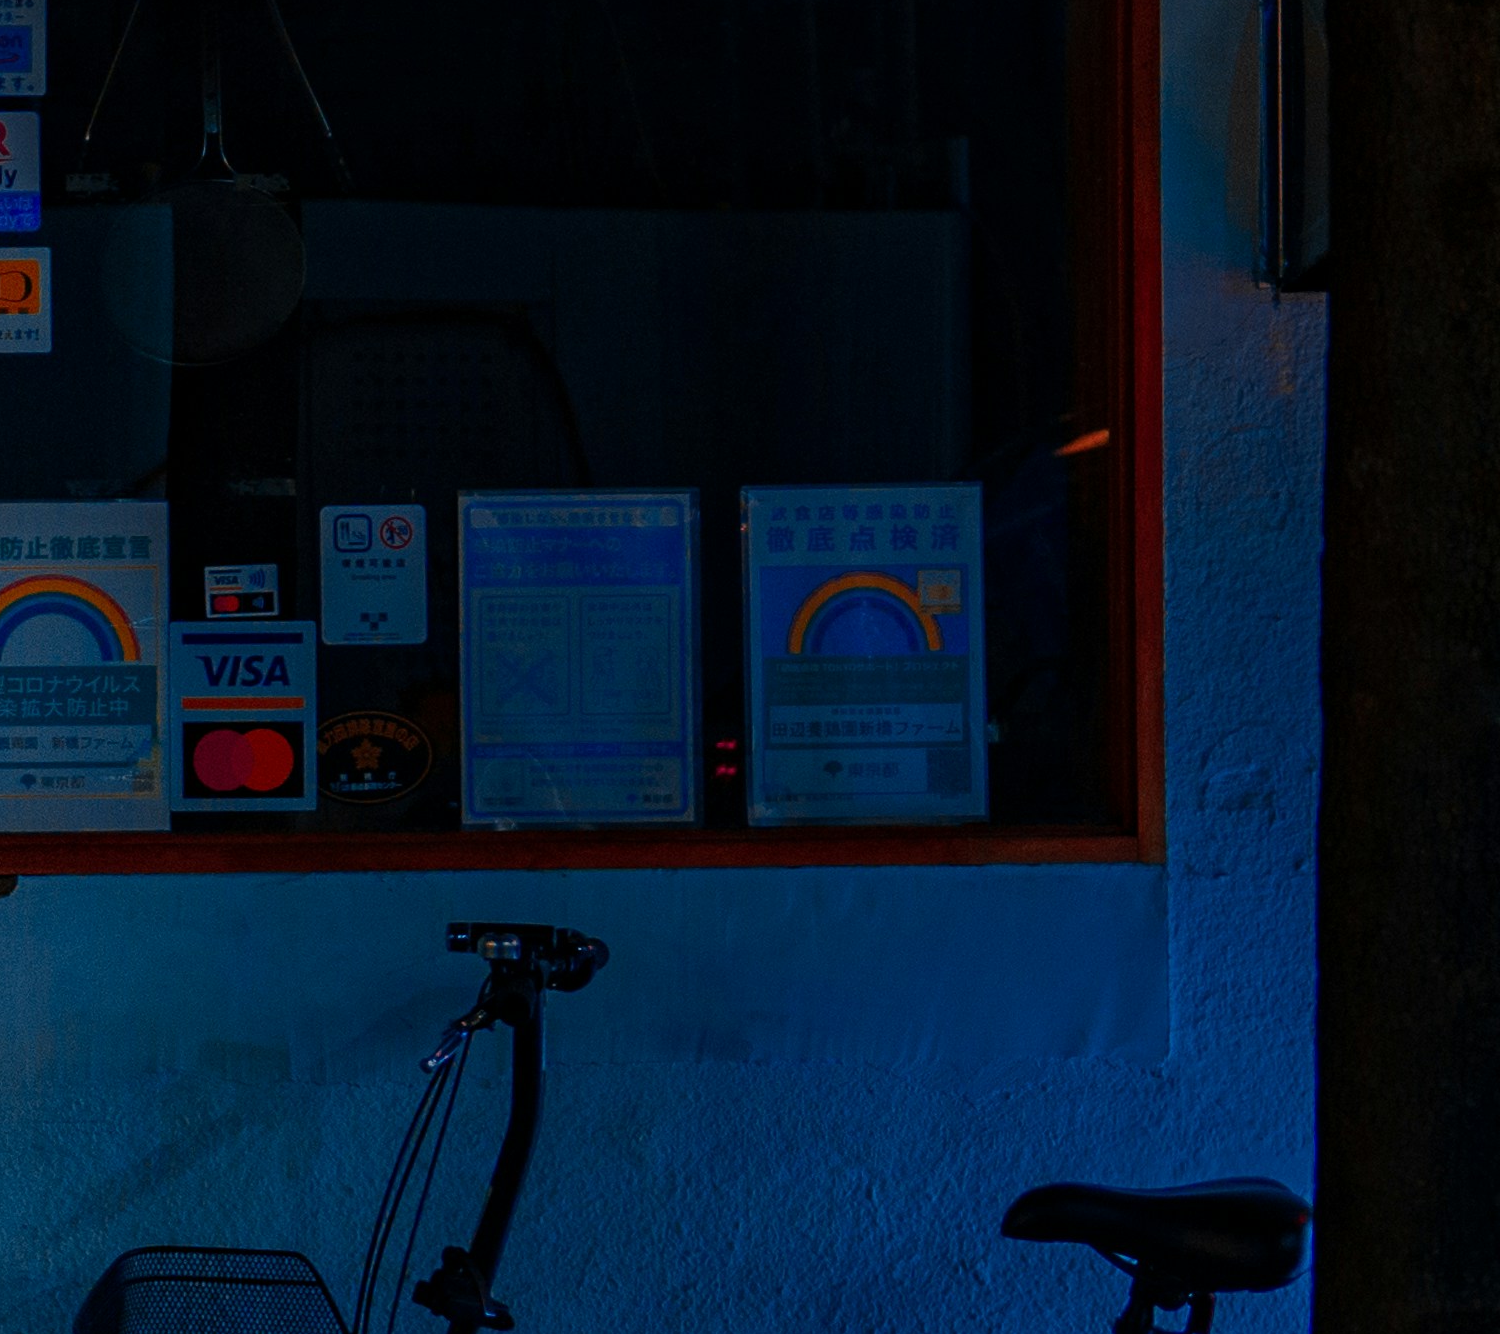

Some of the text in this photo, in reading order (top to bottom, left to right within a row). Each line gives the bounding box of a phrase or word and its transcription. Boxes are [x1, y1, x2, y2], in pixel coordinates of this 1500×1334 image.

[771, 503, 954, 523] 飲食店等感染防止
[766, 524, 961, 553] 徹底点検済
[213, 575, 240, 586] VISA
[195, 655, 291, 687] VISA
[771, 719, 961, 739] 田辺養鶏園新橋ファーム
[847, 761, 900, 777] 東京都
